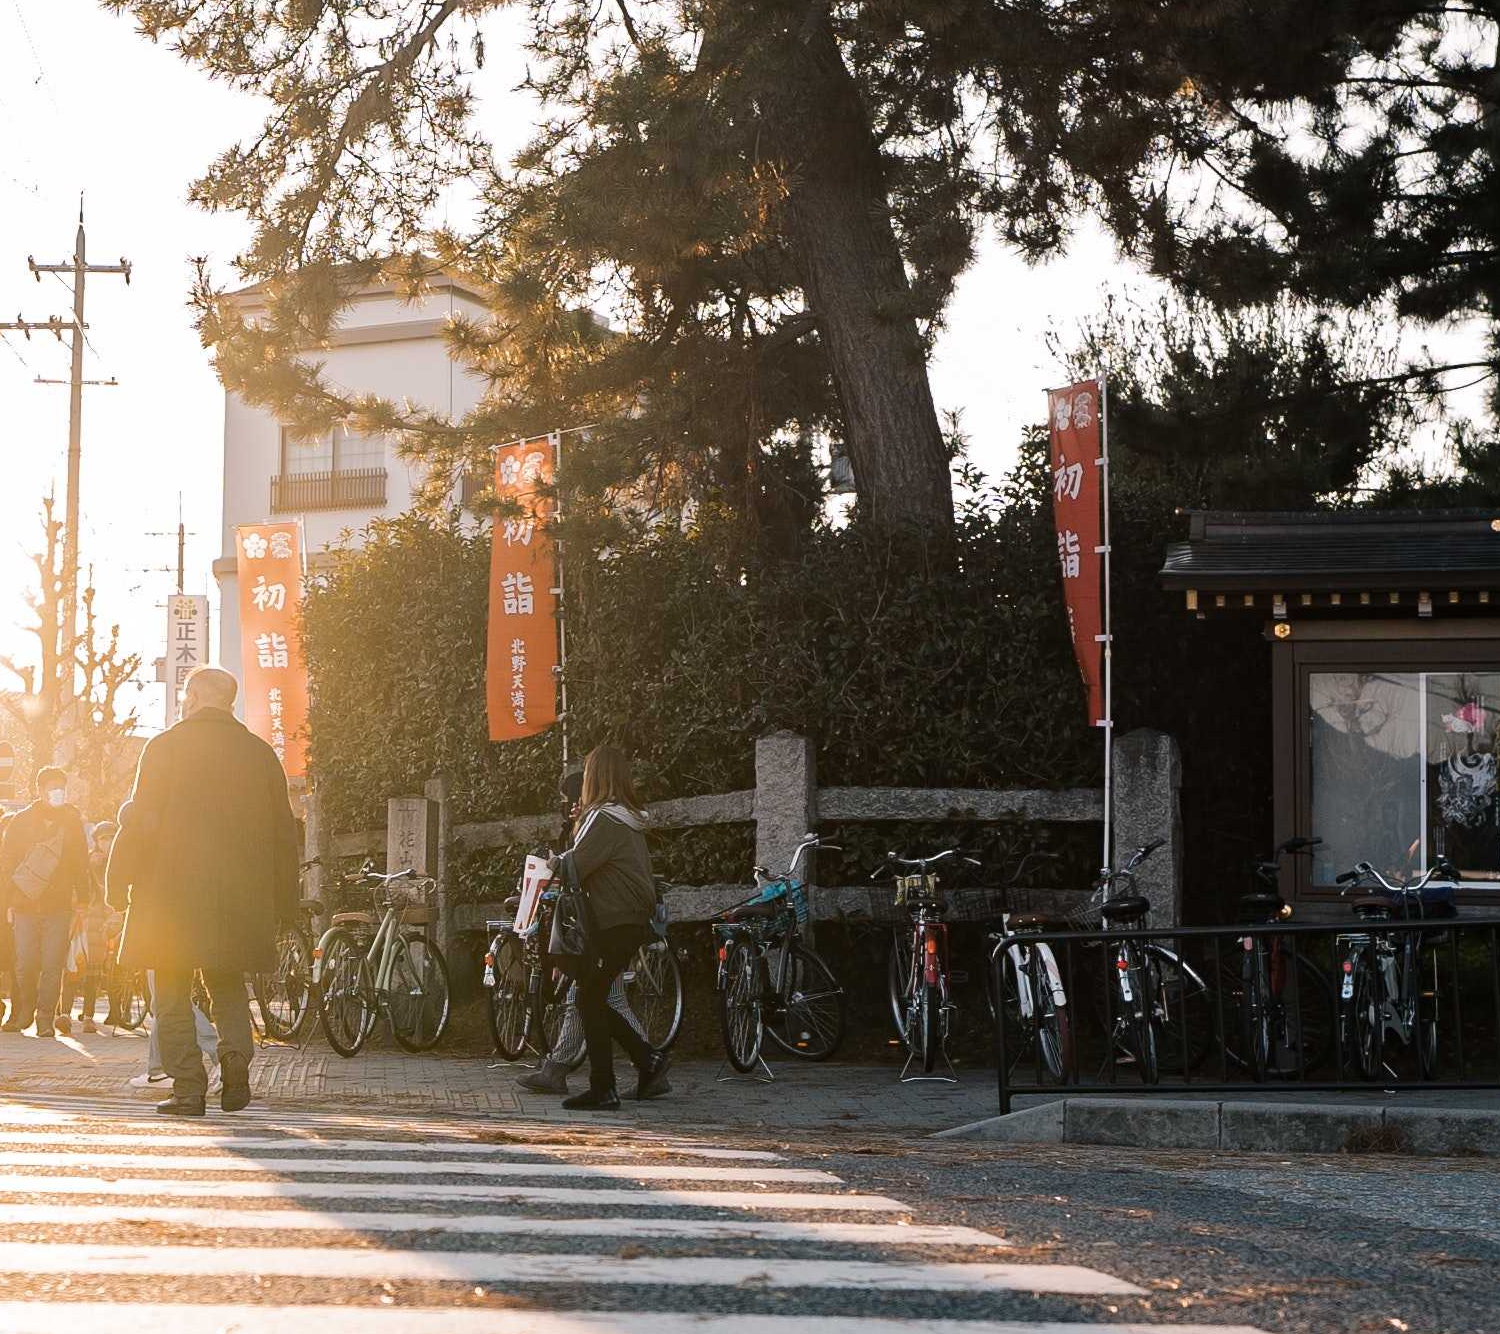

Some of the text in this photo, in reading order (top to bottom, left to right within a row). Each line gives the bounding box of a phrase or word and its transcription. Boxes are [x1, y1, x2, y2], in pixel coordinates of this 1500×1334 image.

[252, 575, 289, 668] 初詣
[510, 637, 528, 725] 北野天満宮
